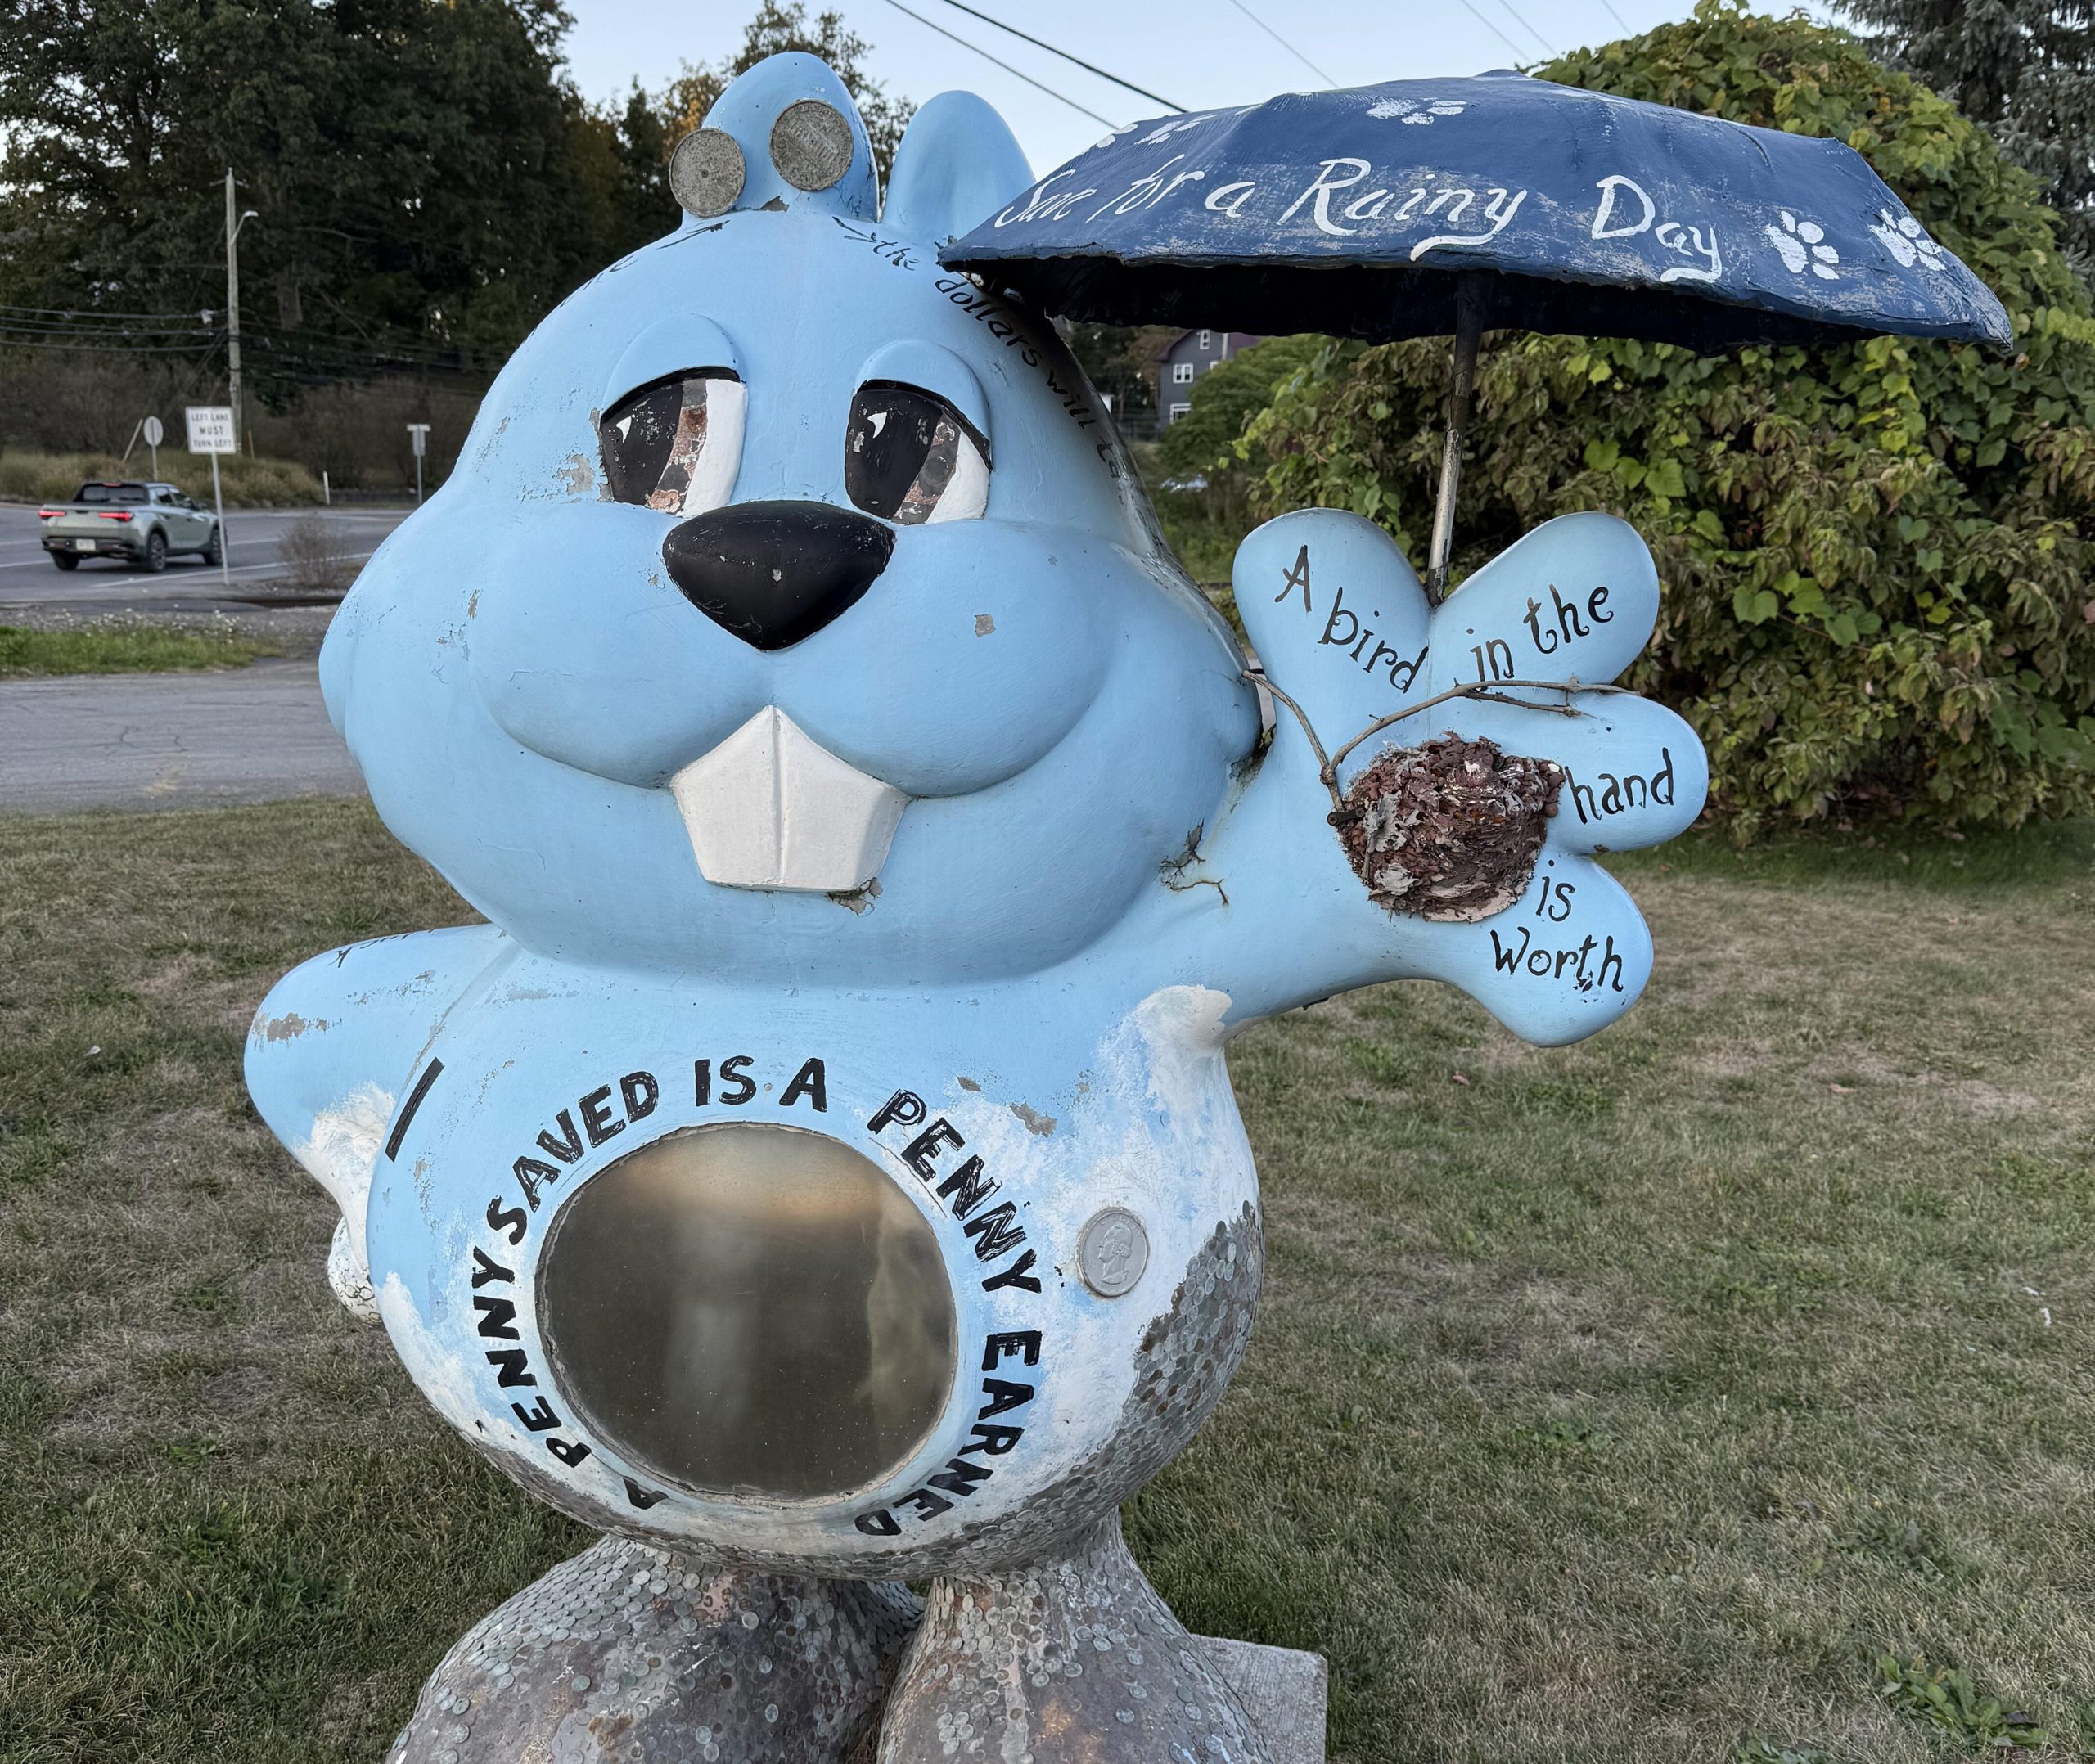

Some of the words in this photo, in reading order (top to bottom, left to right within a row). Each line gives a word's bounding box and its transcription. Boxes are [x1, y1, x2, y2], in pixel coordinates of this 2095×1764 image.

[994, 169, 1097, 228] Save
[1084, 153, 1205, 224] for
[1205, 181, 1255, 218] a
[1277, 157, 1527, 261] Rainy
[1591, 174, 1722, 284] Day
[935, 278, 1043, 367] dollars
[1047, 370, 1097, 430] will
[199, 425, 223, 435] MUST
[1274, 544, 1311, 612] A
[1318, 586, 1429, 694] bird
[1466, 628, 1515, 691] in
[1523, 583, 1614, 655] the
[1565, 746, 1674, 825] hand
[1536, 859, 1576, 922] is
[694, 1055, 756, 1107] IS
[778, 1057, 828, 1113] A
[486, 1070, 660, 1246] SAVED
[866, 1088, 1043, 1294] PENNY
[471, 1245, 592, 1469] PENNY
[854, 1330, 1043, 1537] EARNED
[623, 1476, 668, 1511] A
